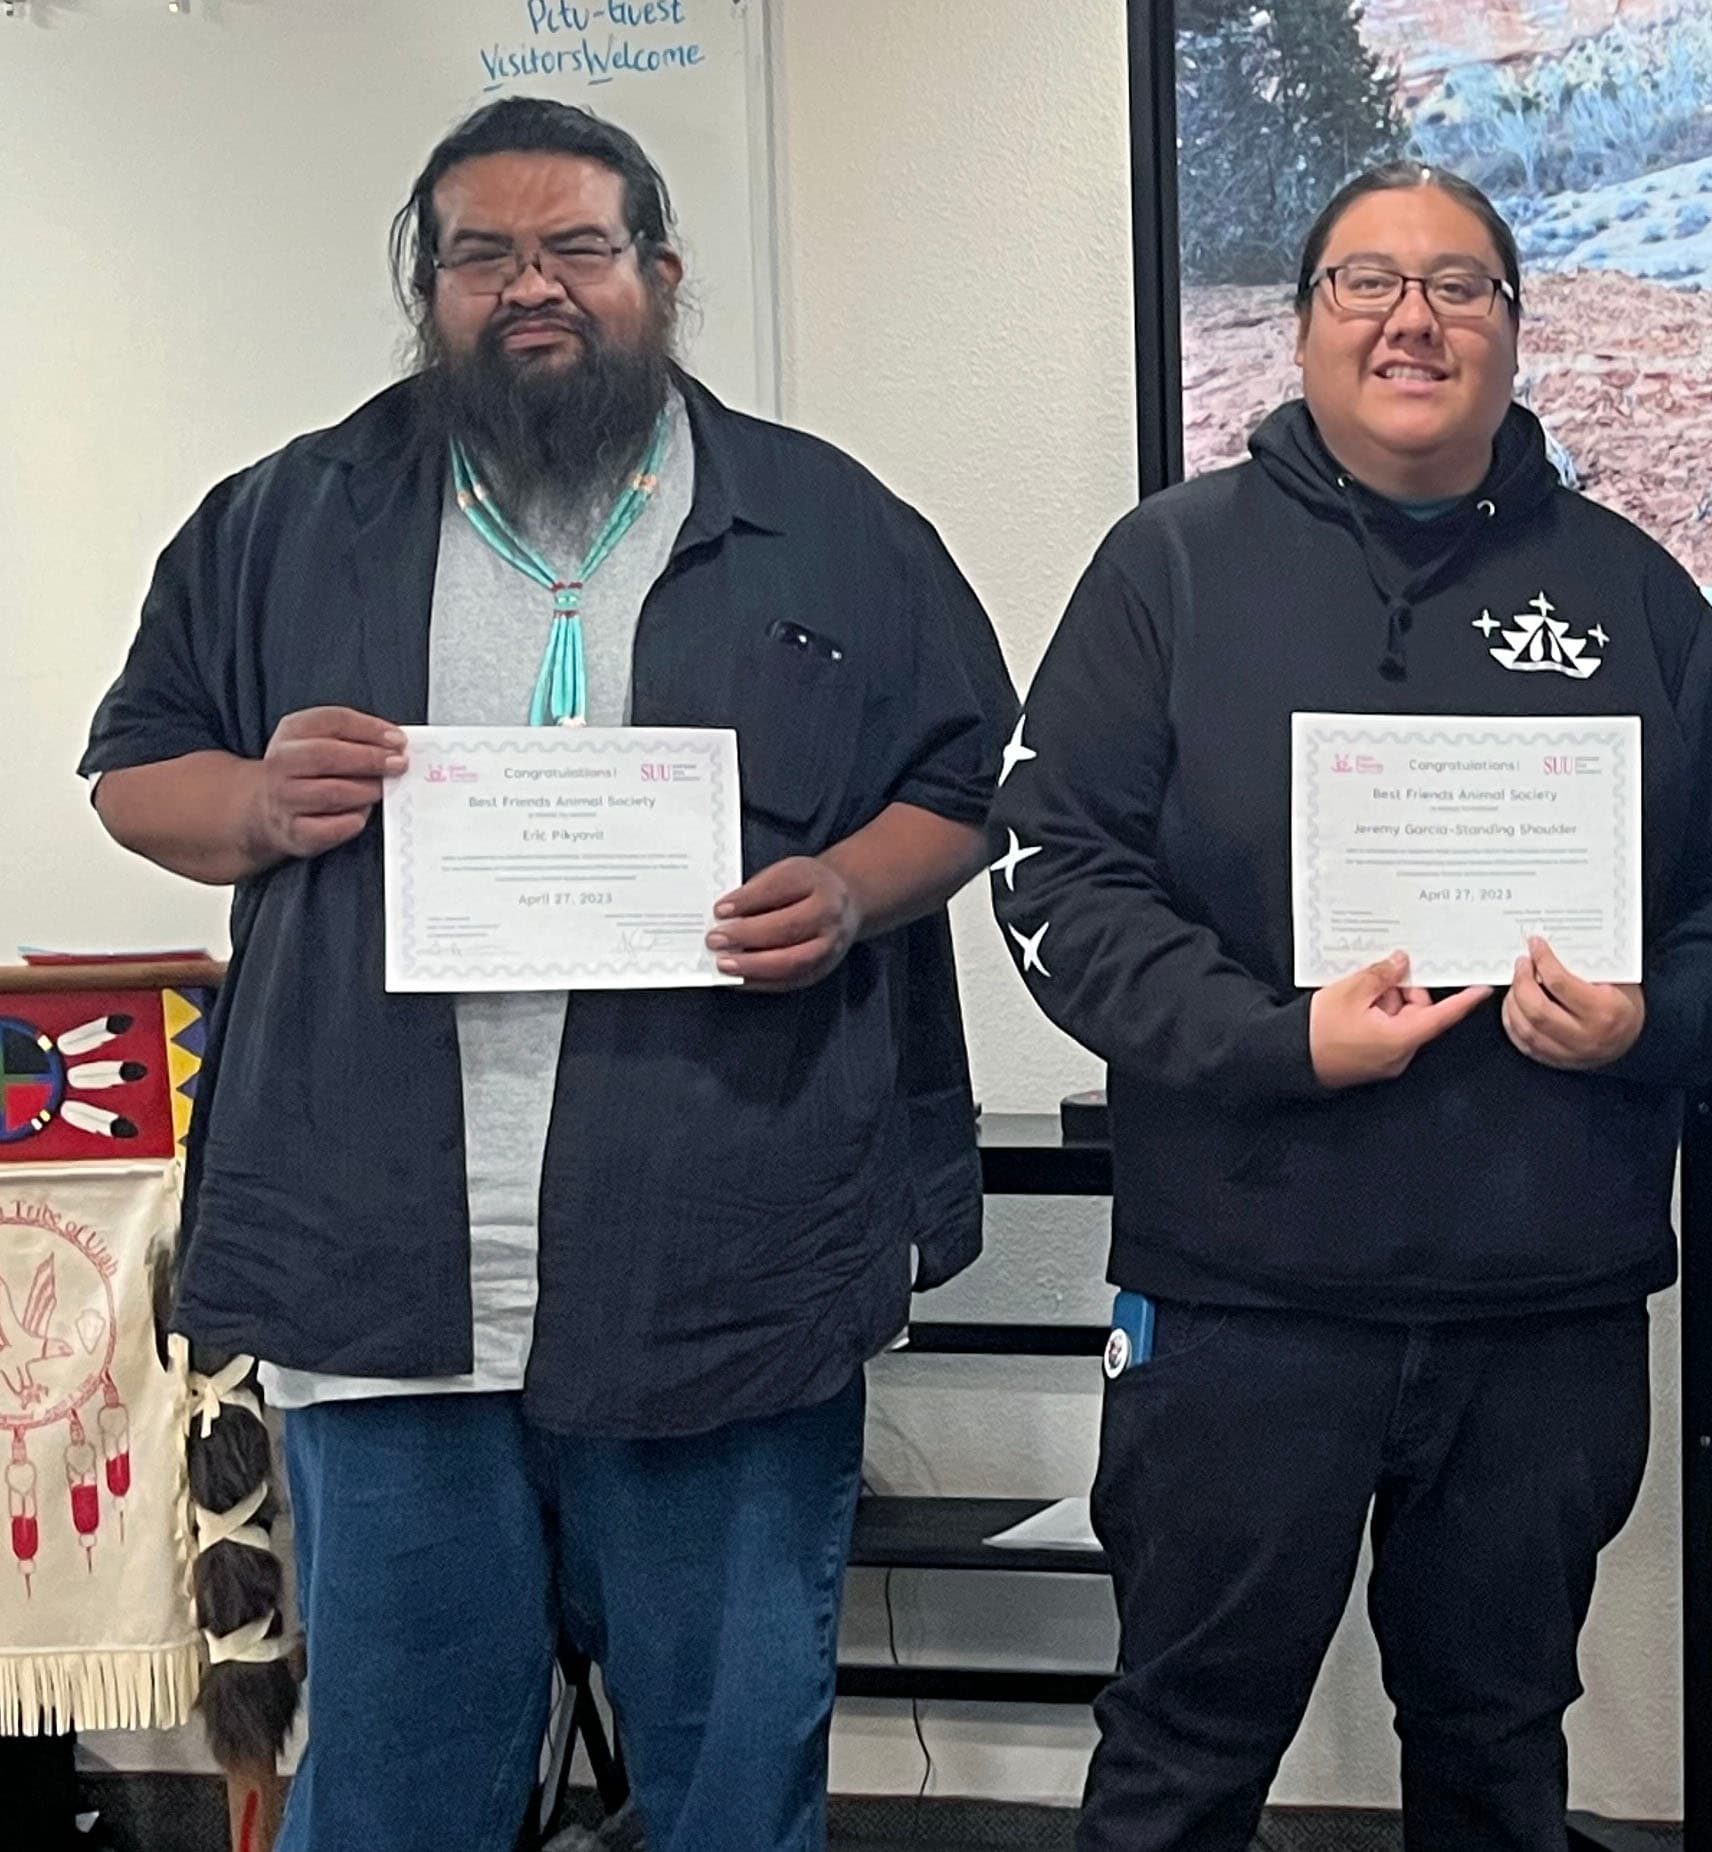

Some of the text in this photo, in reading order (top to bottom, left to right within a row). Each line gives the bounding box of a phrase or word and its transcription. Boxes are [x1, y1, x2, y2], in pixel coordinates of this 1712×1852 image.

[1409, 758, 1520, 773] Congratulations!
[1543, 756, 1574, 775] SUU
[503, 767, 617, 782] Congratulations!
[640, 763, 672, 783] SUU
[1373, 788, 1558, 802] Best Friends Animal Society
[468, 796, 656, 809] Best Friends Animal Society
[1354, 824, 1400, 837] Jeremy
[1520, 823, 1577, 835] Shoulder
[518, 893, 550, 907] April
[580, 893, 613, 905] 2023
[1419, 889, 1450, 901] April
[1480, 888, 1513, 900] 2023
